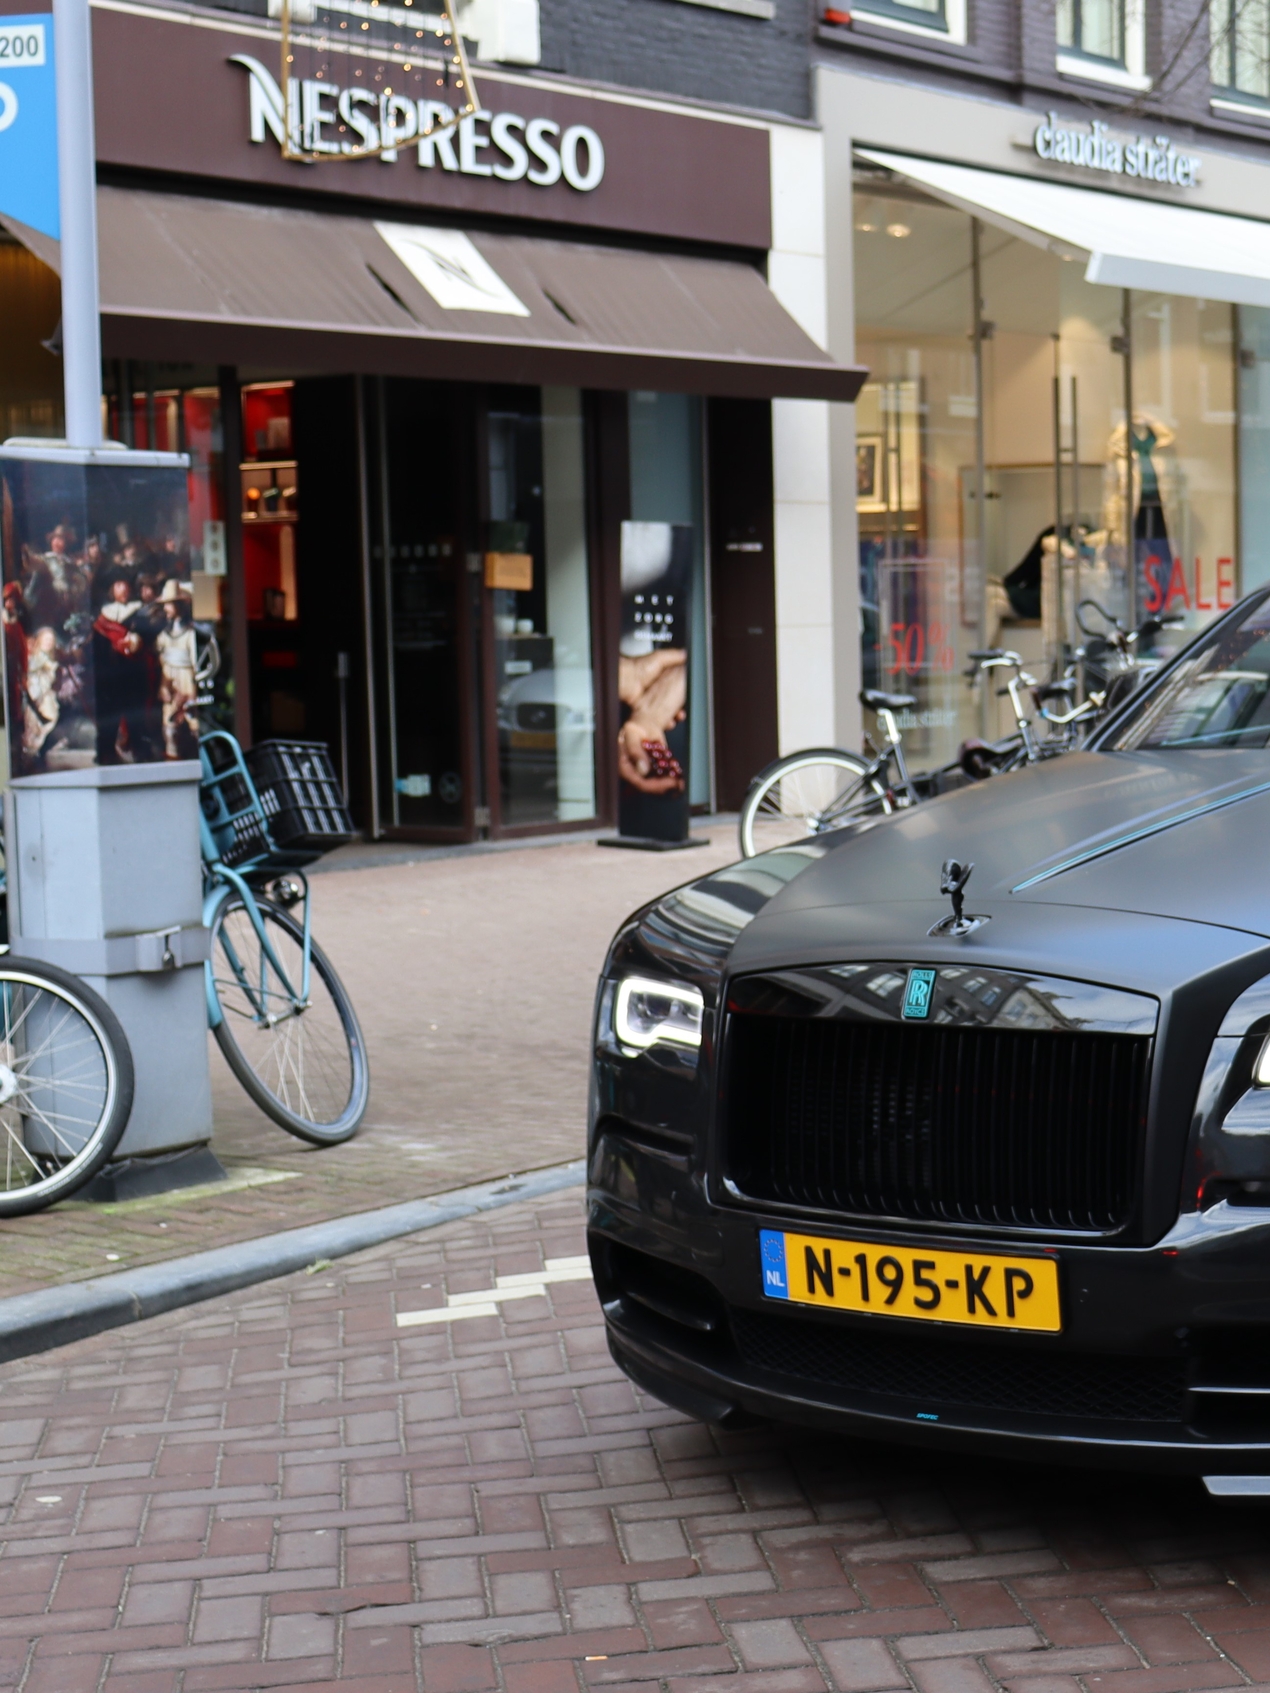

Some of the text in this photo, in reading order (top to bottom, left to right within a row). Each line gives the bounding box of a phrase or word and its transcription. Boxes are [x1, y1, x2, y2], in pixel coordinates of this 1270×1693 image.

[227, 53, 605, 191] NESPRESSO
[1034, 110, 1201, 187] claudia sträter
[1143, 554, 1235, 614] SALE
[766, 1245, 1034, 1319] NL N-195-KP
